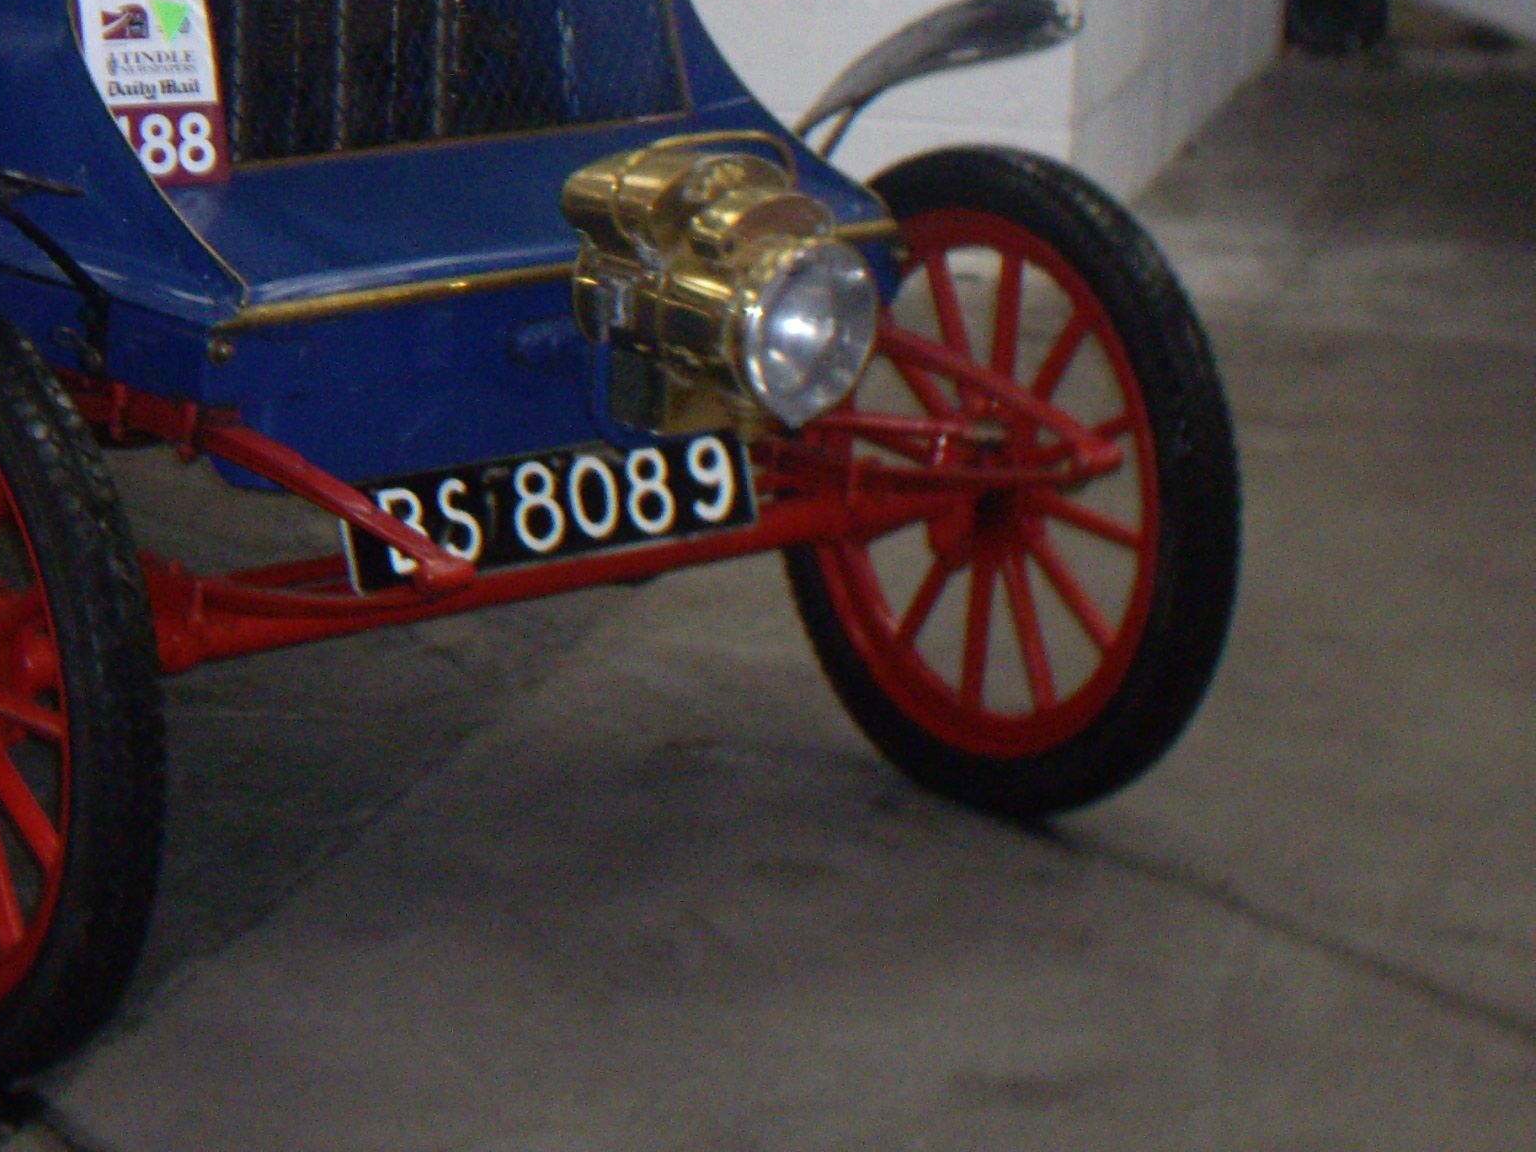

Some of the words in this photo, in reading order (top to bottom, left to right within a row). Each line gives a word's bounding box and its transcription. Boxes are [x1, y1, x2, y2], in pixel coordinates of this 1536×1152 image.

[118, 50, 193, 64] TINDLE
[106, 80, 156, 100] Daily
[158, 79, 201, 95] Mail
[512, 435, 734, 553] 8089
